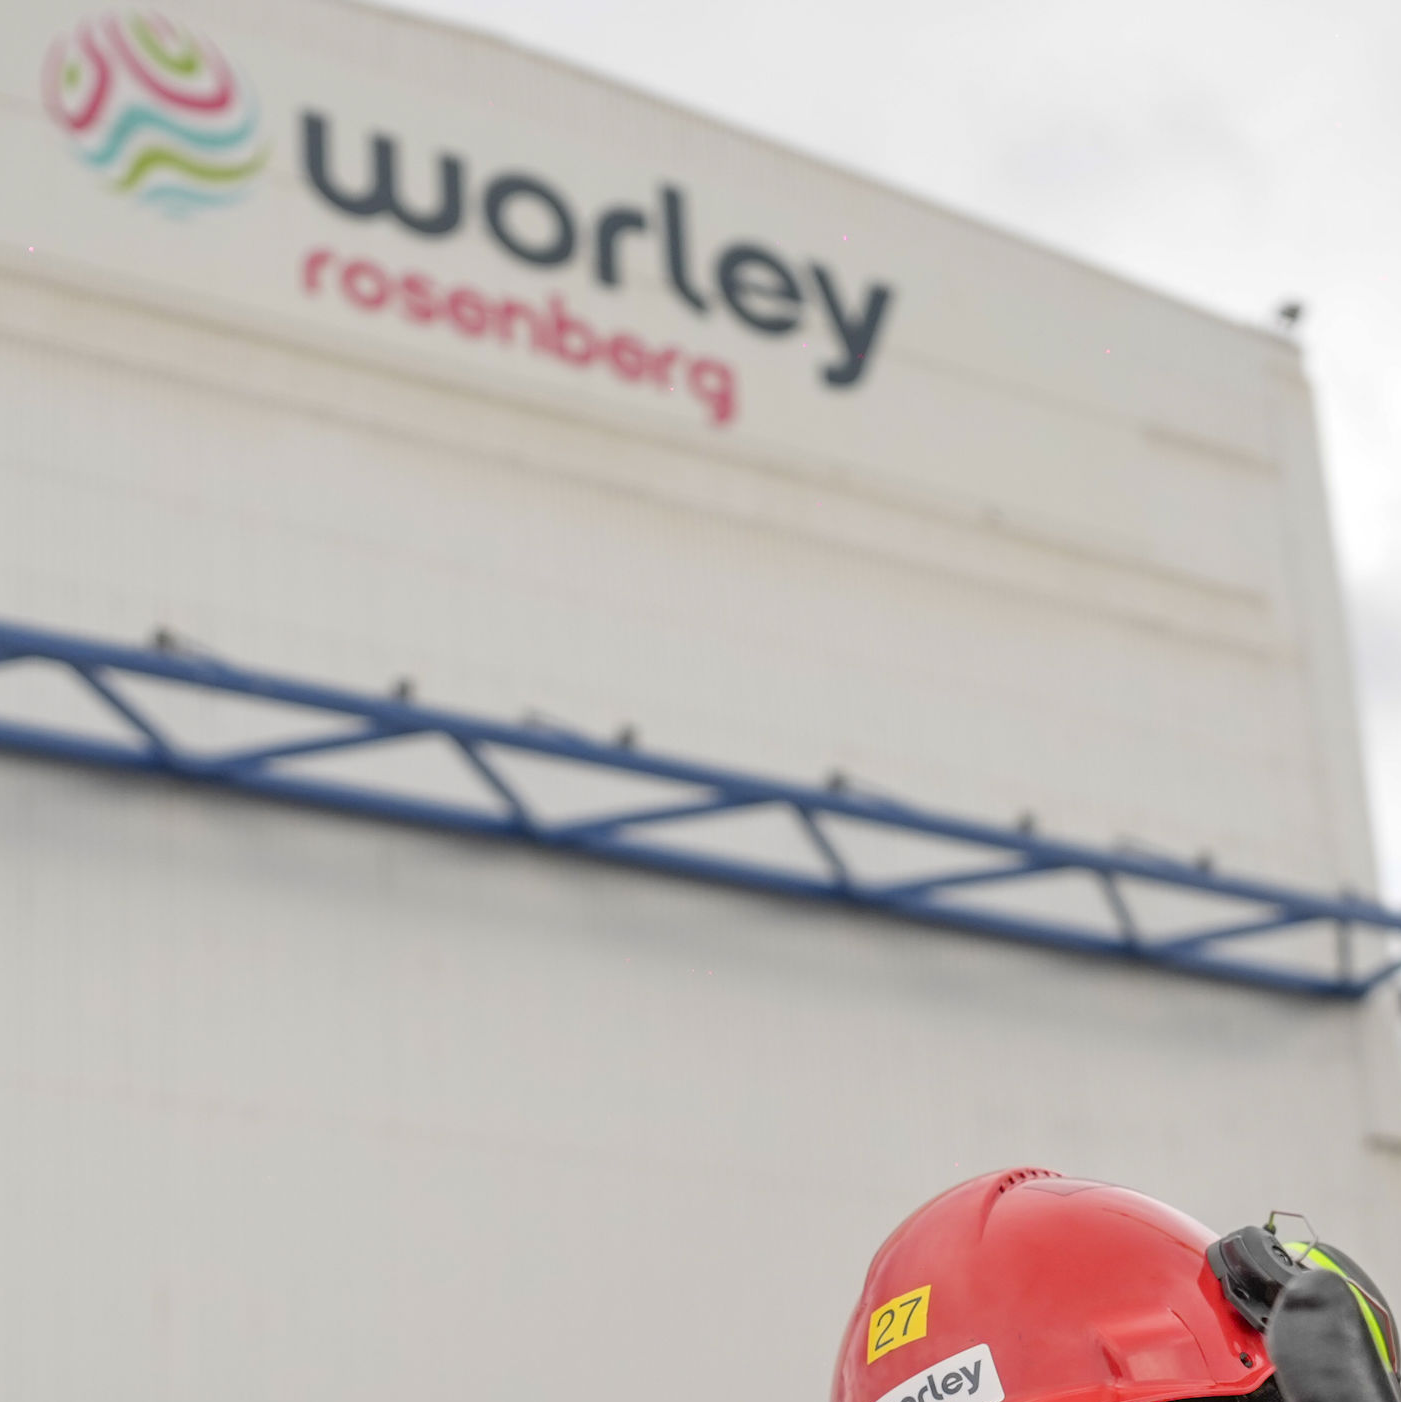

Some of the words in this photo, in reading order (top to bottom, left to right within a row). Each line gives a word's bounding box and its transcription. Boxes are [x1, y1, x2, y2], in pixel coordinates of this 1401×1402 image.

[300, 110, 892, 389] worley
[302, 246, 738, 424] rosenberg
[874, 1296, 923, 1352] 27
